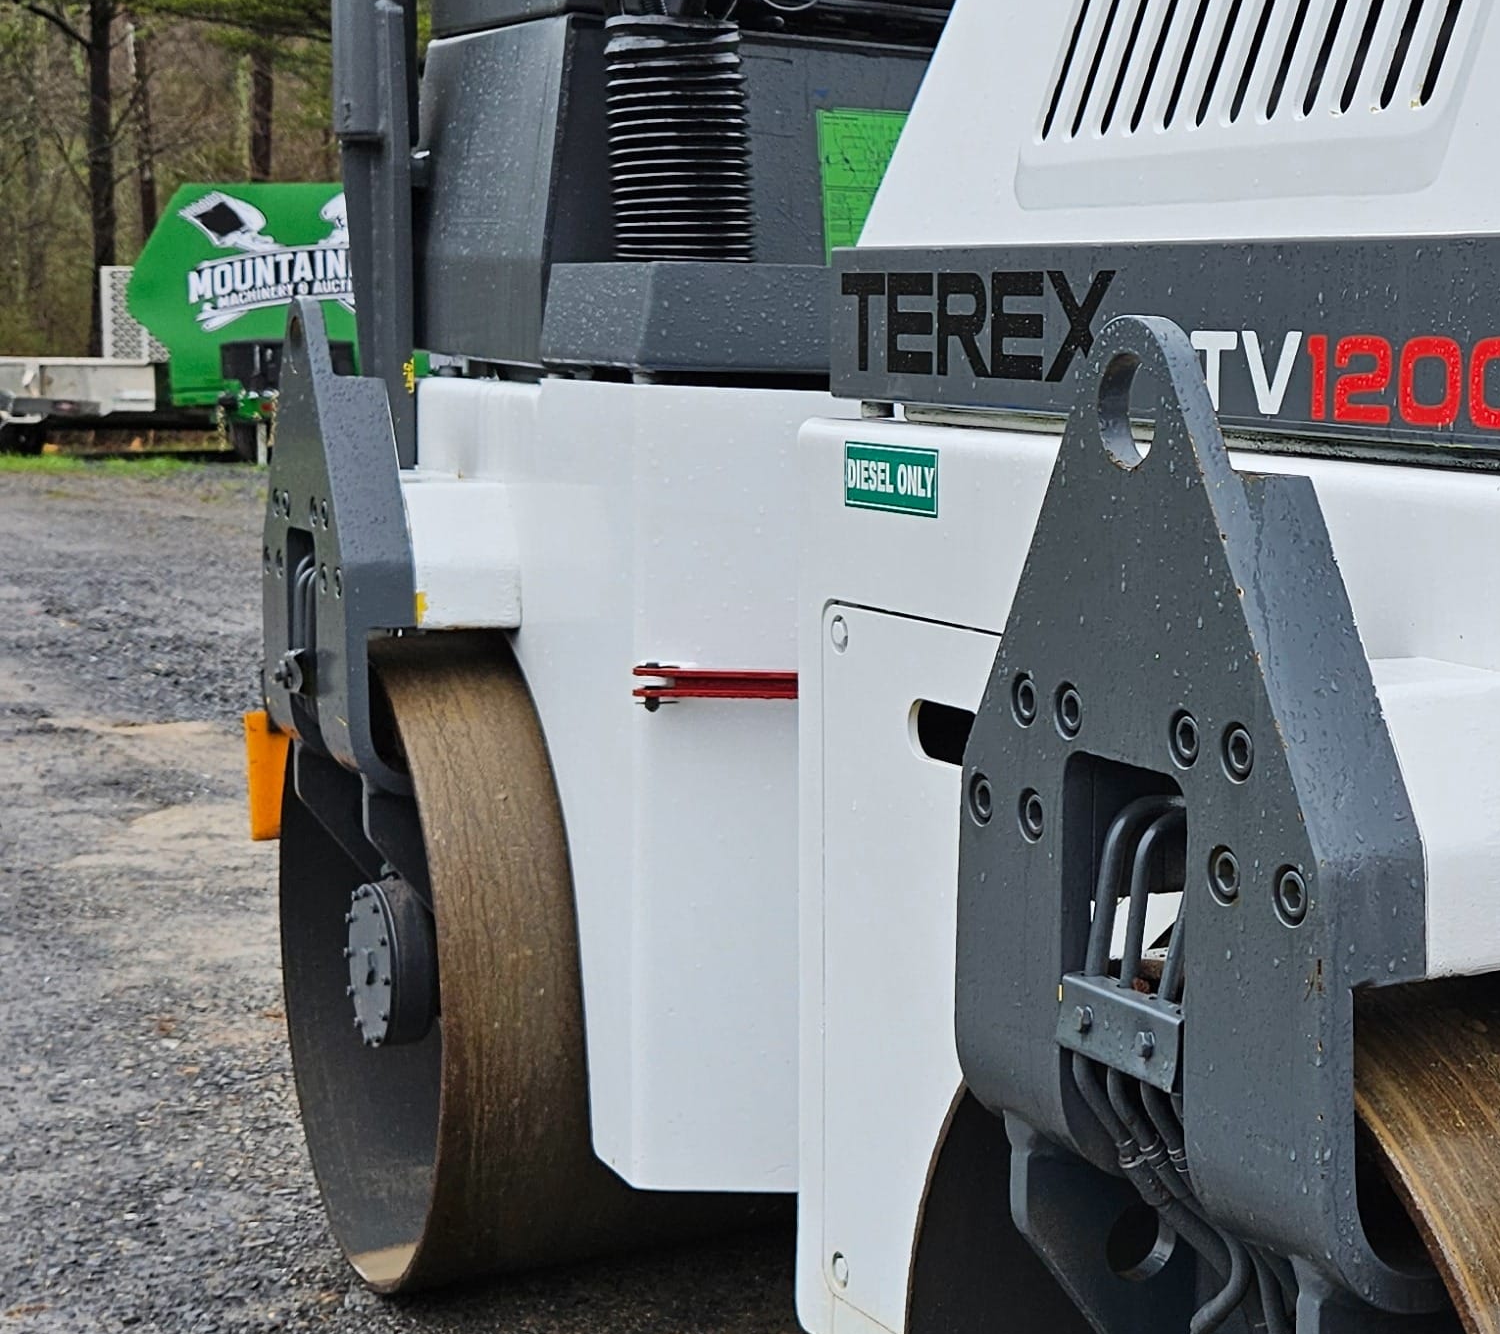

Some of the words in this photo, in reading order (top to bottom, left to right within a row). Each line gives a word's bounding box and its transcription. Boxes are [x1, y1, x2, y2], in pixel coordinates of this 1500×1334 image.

[188, 250, 352, 304] MOUNTAIN
[217, 282, 294, 308] MACHINERY
[841, 269, 1117, 383] TEREX
[847, 458, 894, 493] DIESEL
[897, 463, 935, 498] ONLY
